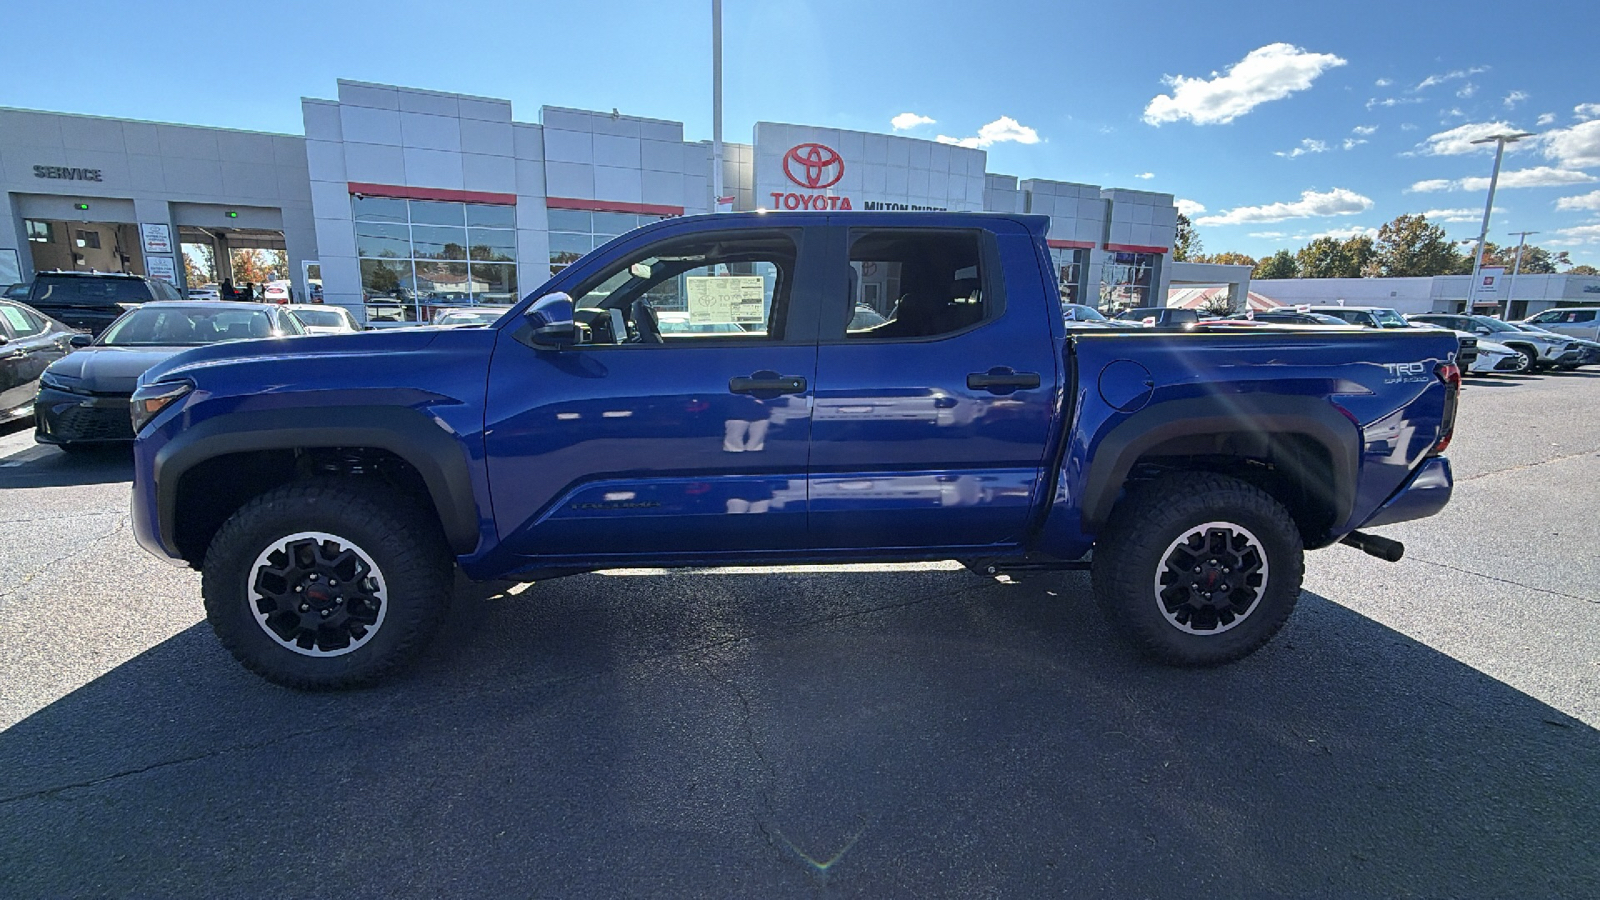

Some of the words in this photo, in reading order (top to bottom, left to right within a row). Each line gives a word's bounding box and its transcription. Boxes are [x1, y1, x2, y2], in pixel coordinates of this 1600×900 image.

[33, 164, 103, 182] SERVICE
[770, 192, 852, 211] TOYOTA
[1383, 362, 1423, 376] TRD
